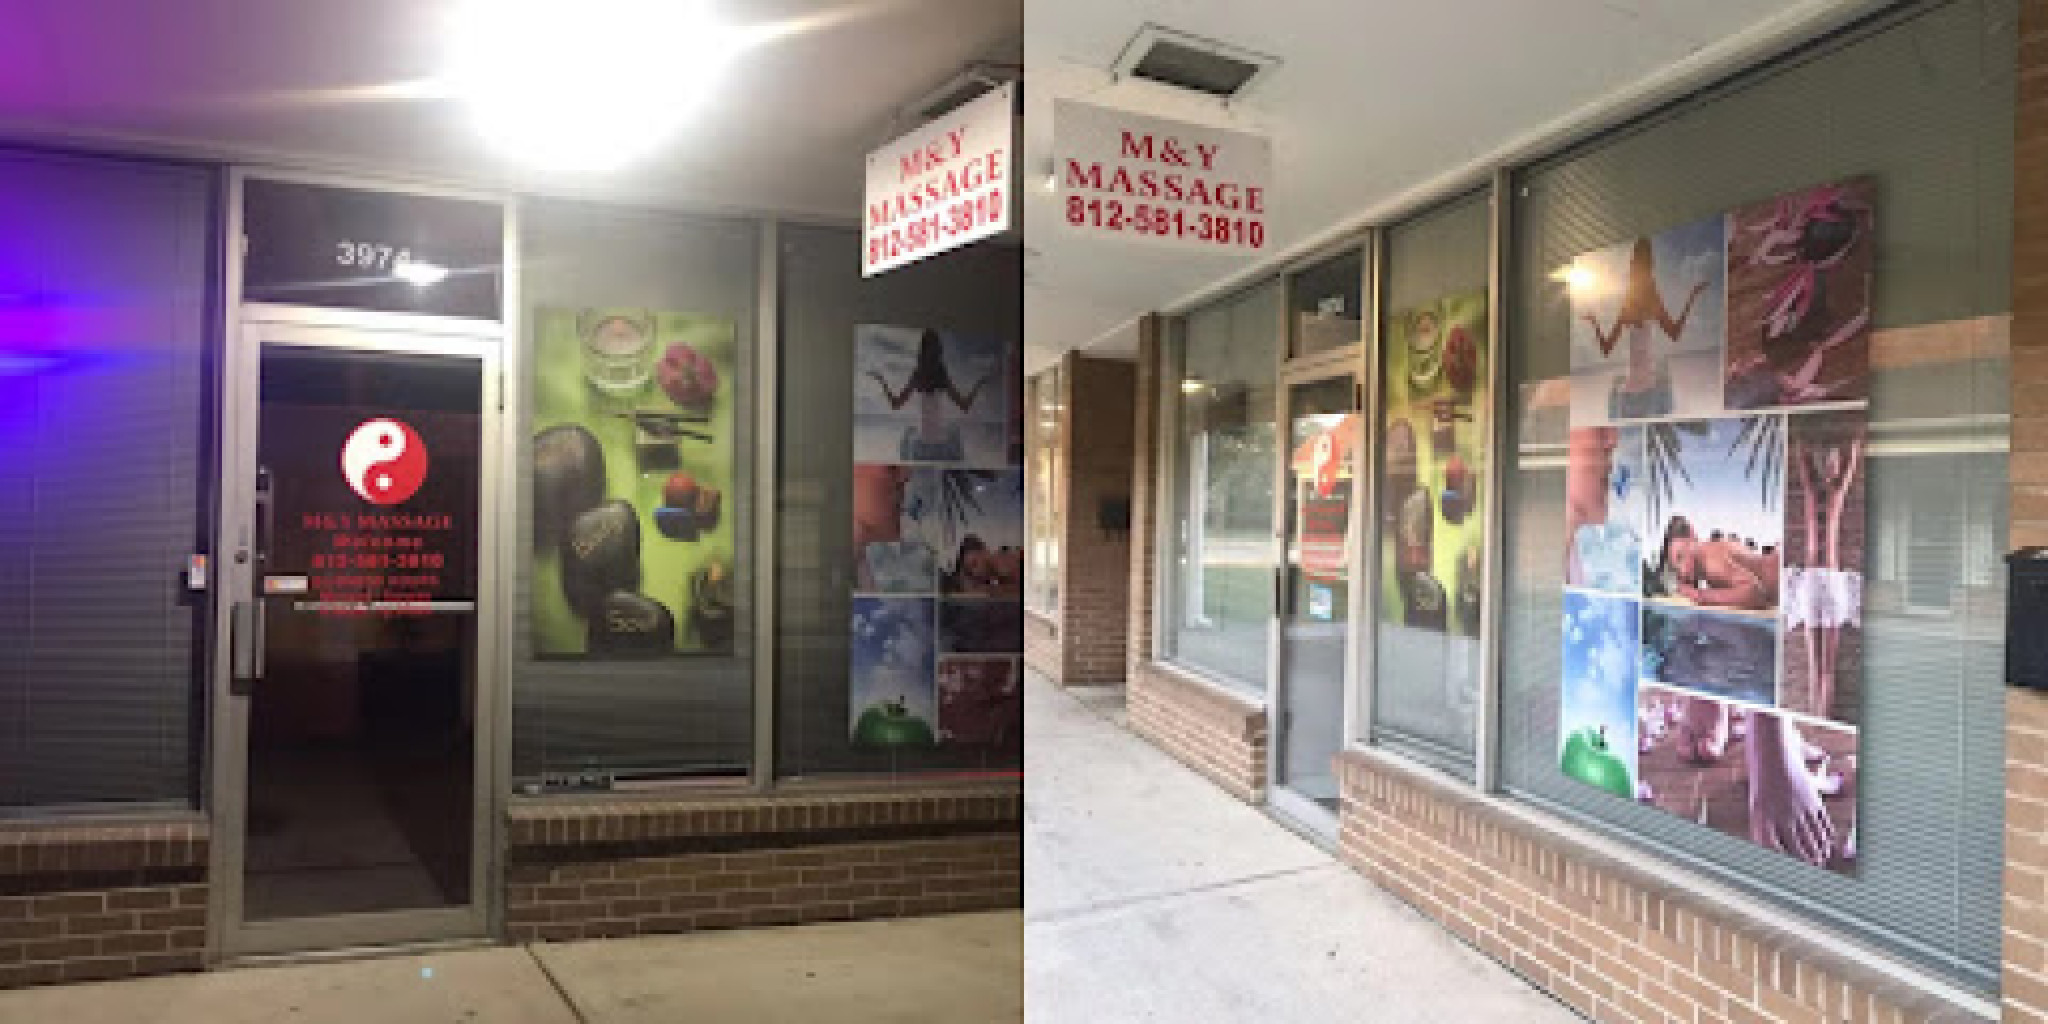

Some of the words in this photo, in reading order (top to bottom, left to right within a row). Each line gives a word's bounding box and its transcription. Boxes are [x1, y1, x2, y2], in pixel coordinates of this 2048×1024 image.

[900, 124, 968, 184] M&Y
[1119, 130, 1219, 171] M&Y
[869, 149, 1003, 230] MASSAGE
[1066, 158, 1264, 214] MASSAGE
[869, 188, 1003, 264] 812-581-3810
[1066, 195, 1265, 249] 812-581-3810
